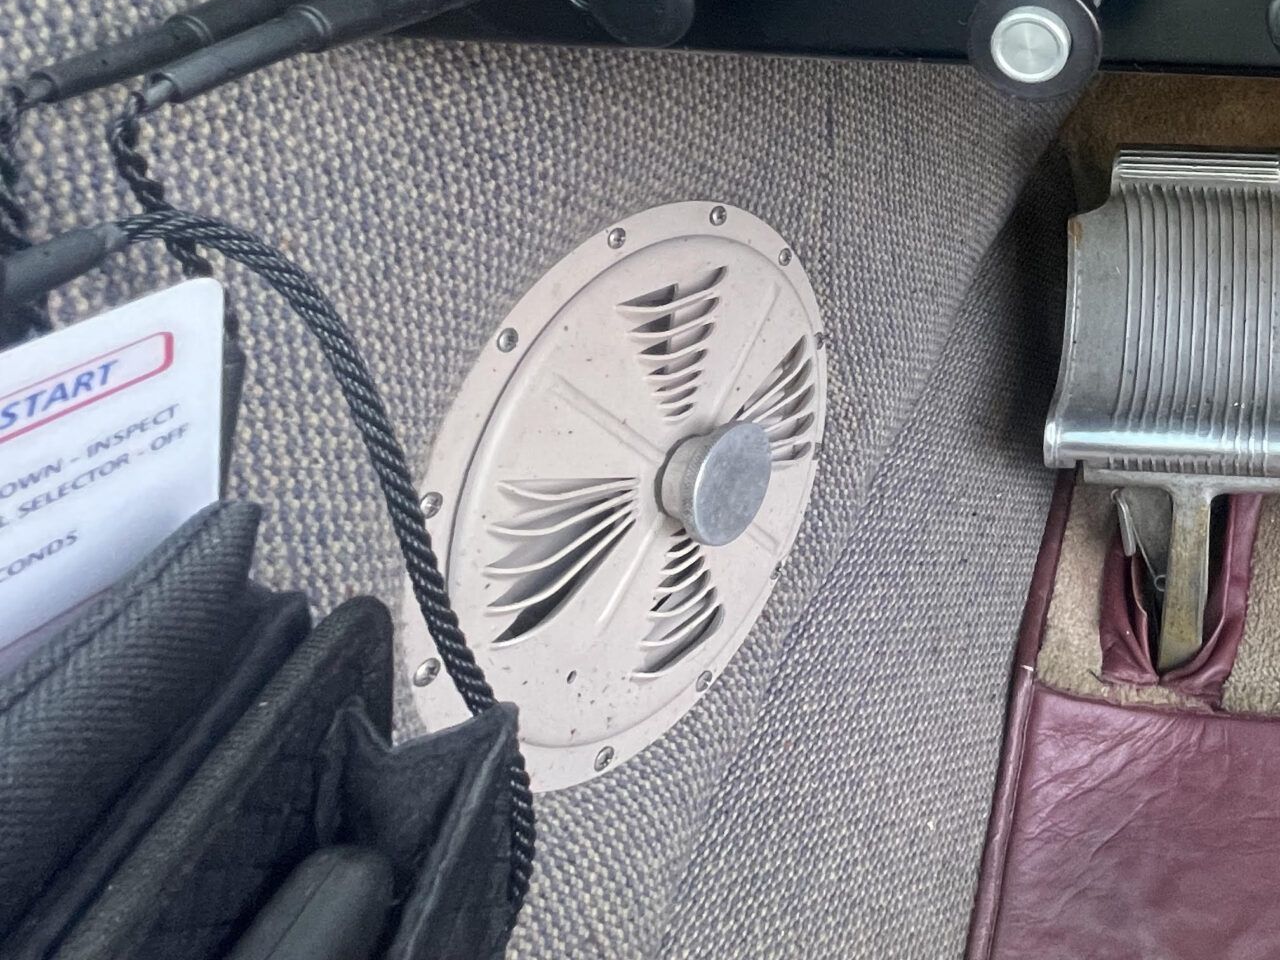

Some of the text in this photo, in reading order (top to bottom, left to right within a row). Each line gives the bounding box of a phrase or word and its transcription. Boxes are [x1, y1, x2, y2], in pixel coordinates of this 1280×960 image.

[0, 359, 119, 430] START
[86, 403, 180, 458] INSPECT
[18, 452, 130, 519] SELECTOR
[150, 422, 190, 452] OFF
